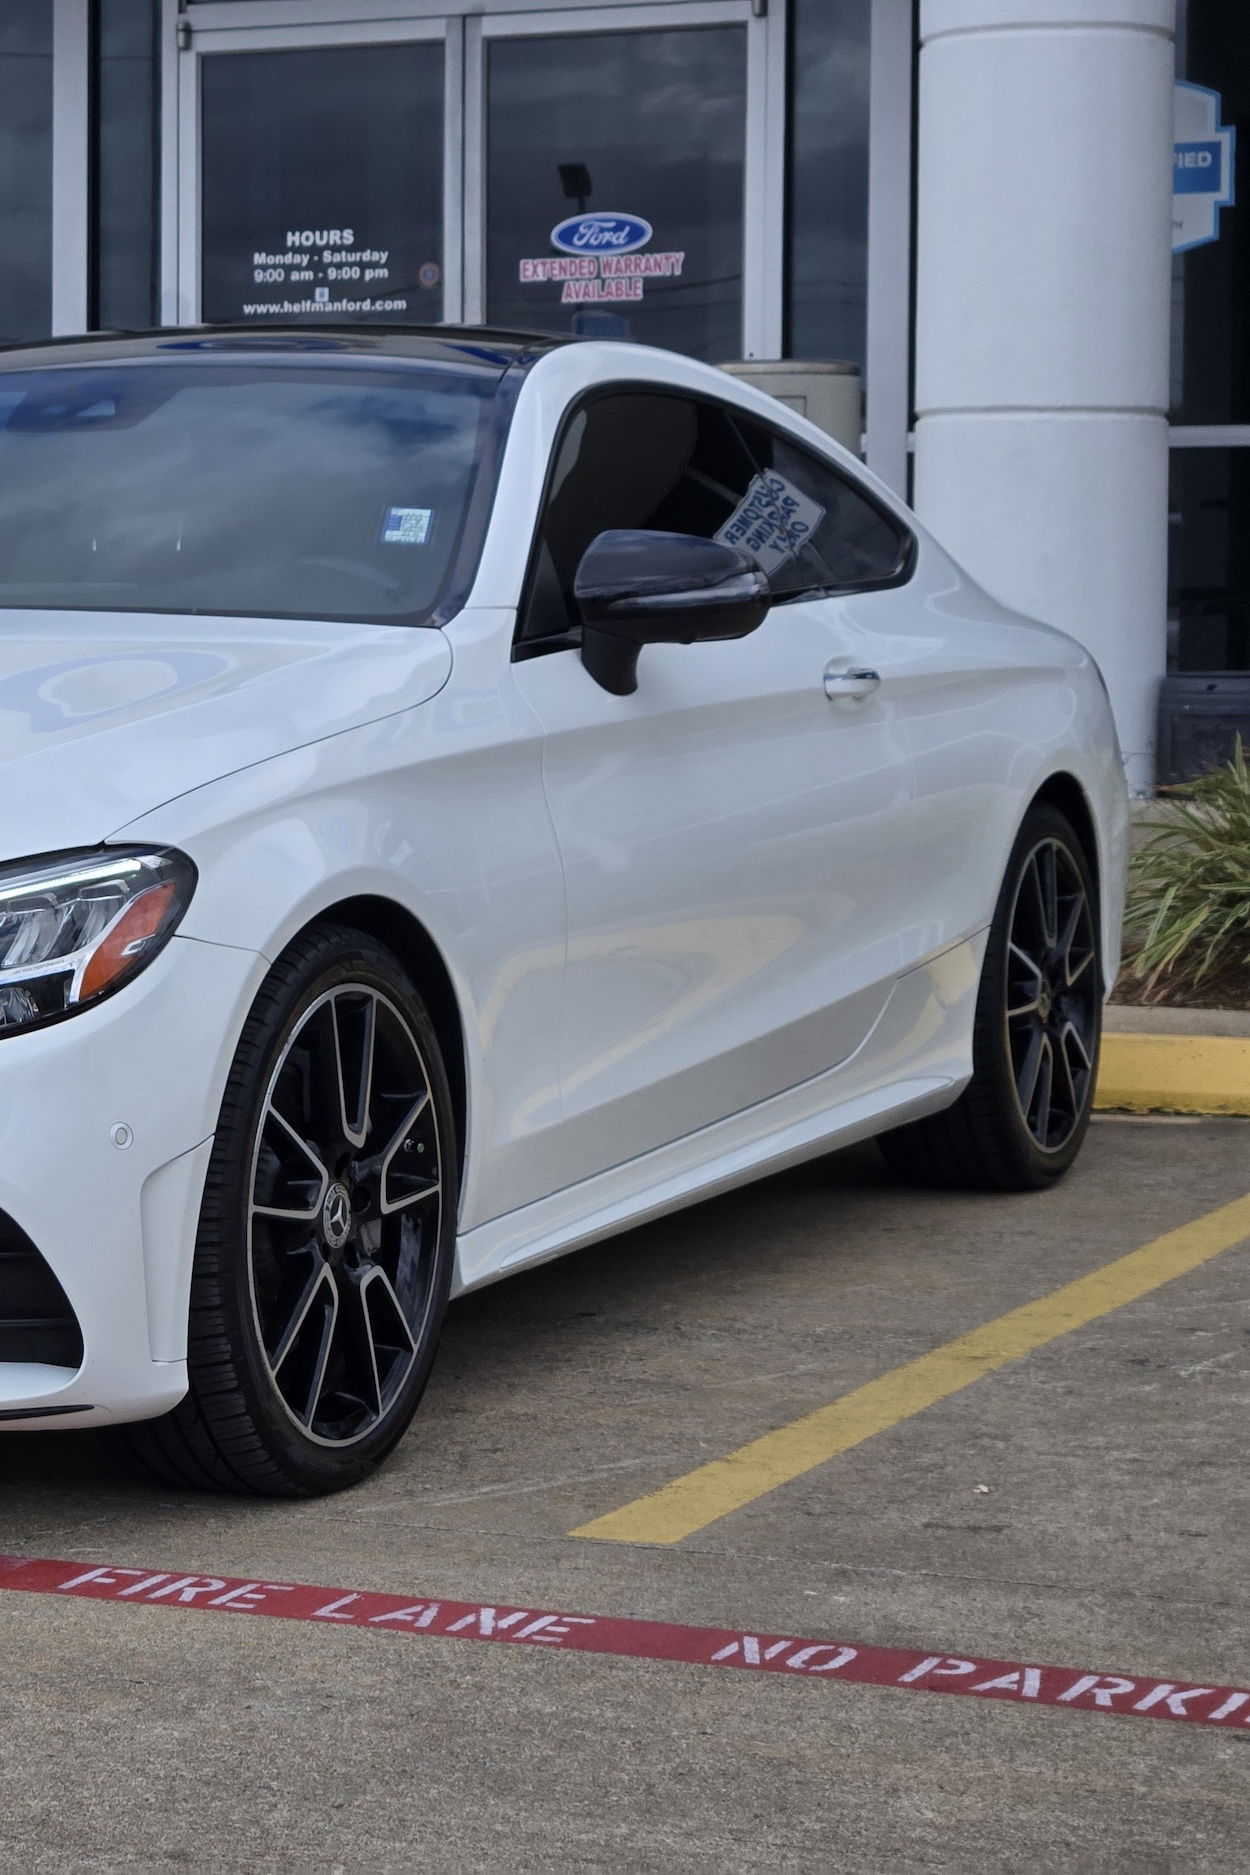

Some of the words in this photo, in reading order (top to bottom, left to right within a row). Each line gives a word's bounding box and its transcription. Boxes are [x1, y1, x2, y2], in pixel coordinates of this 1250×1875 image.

[286, 229, 355, 247] HOURS
[572, 220, 630, 247] Ford
[253, 252, 310, 267] Monday
[323, 250, 389, 265] Saturday
[520, 258, 597, 282] EXTENDED
[600, 252, 685, 277] WARRANTY
[253, 268, 285, 283] 9:00
[290, 270, 314, 282] am
[327, 266, 361, 281] 9:00
[364, 267, 389, 282] pm
[561, 278, 643, 303] AVAILABLE
[243, 298, 407, 315] www.helfmanford.com
[57, 1567, 295, 1610] FIRE
[310, 1593, 596, 1642] LANE
[711, 1635, 858, 1672] NO
[897, 1655, 1250, 1723] PARKI
